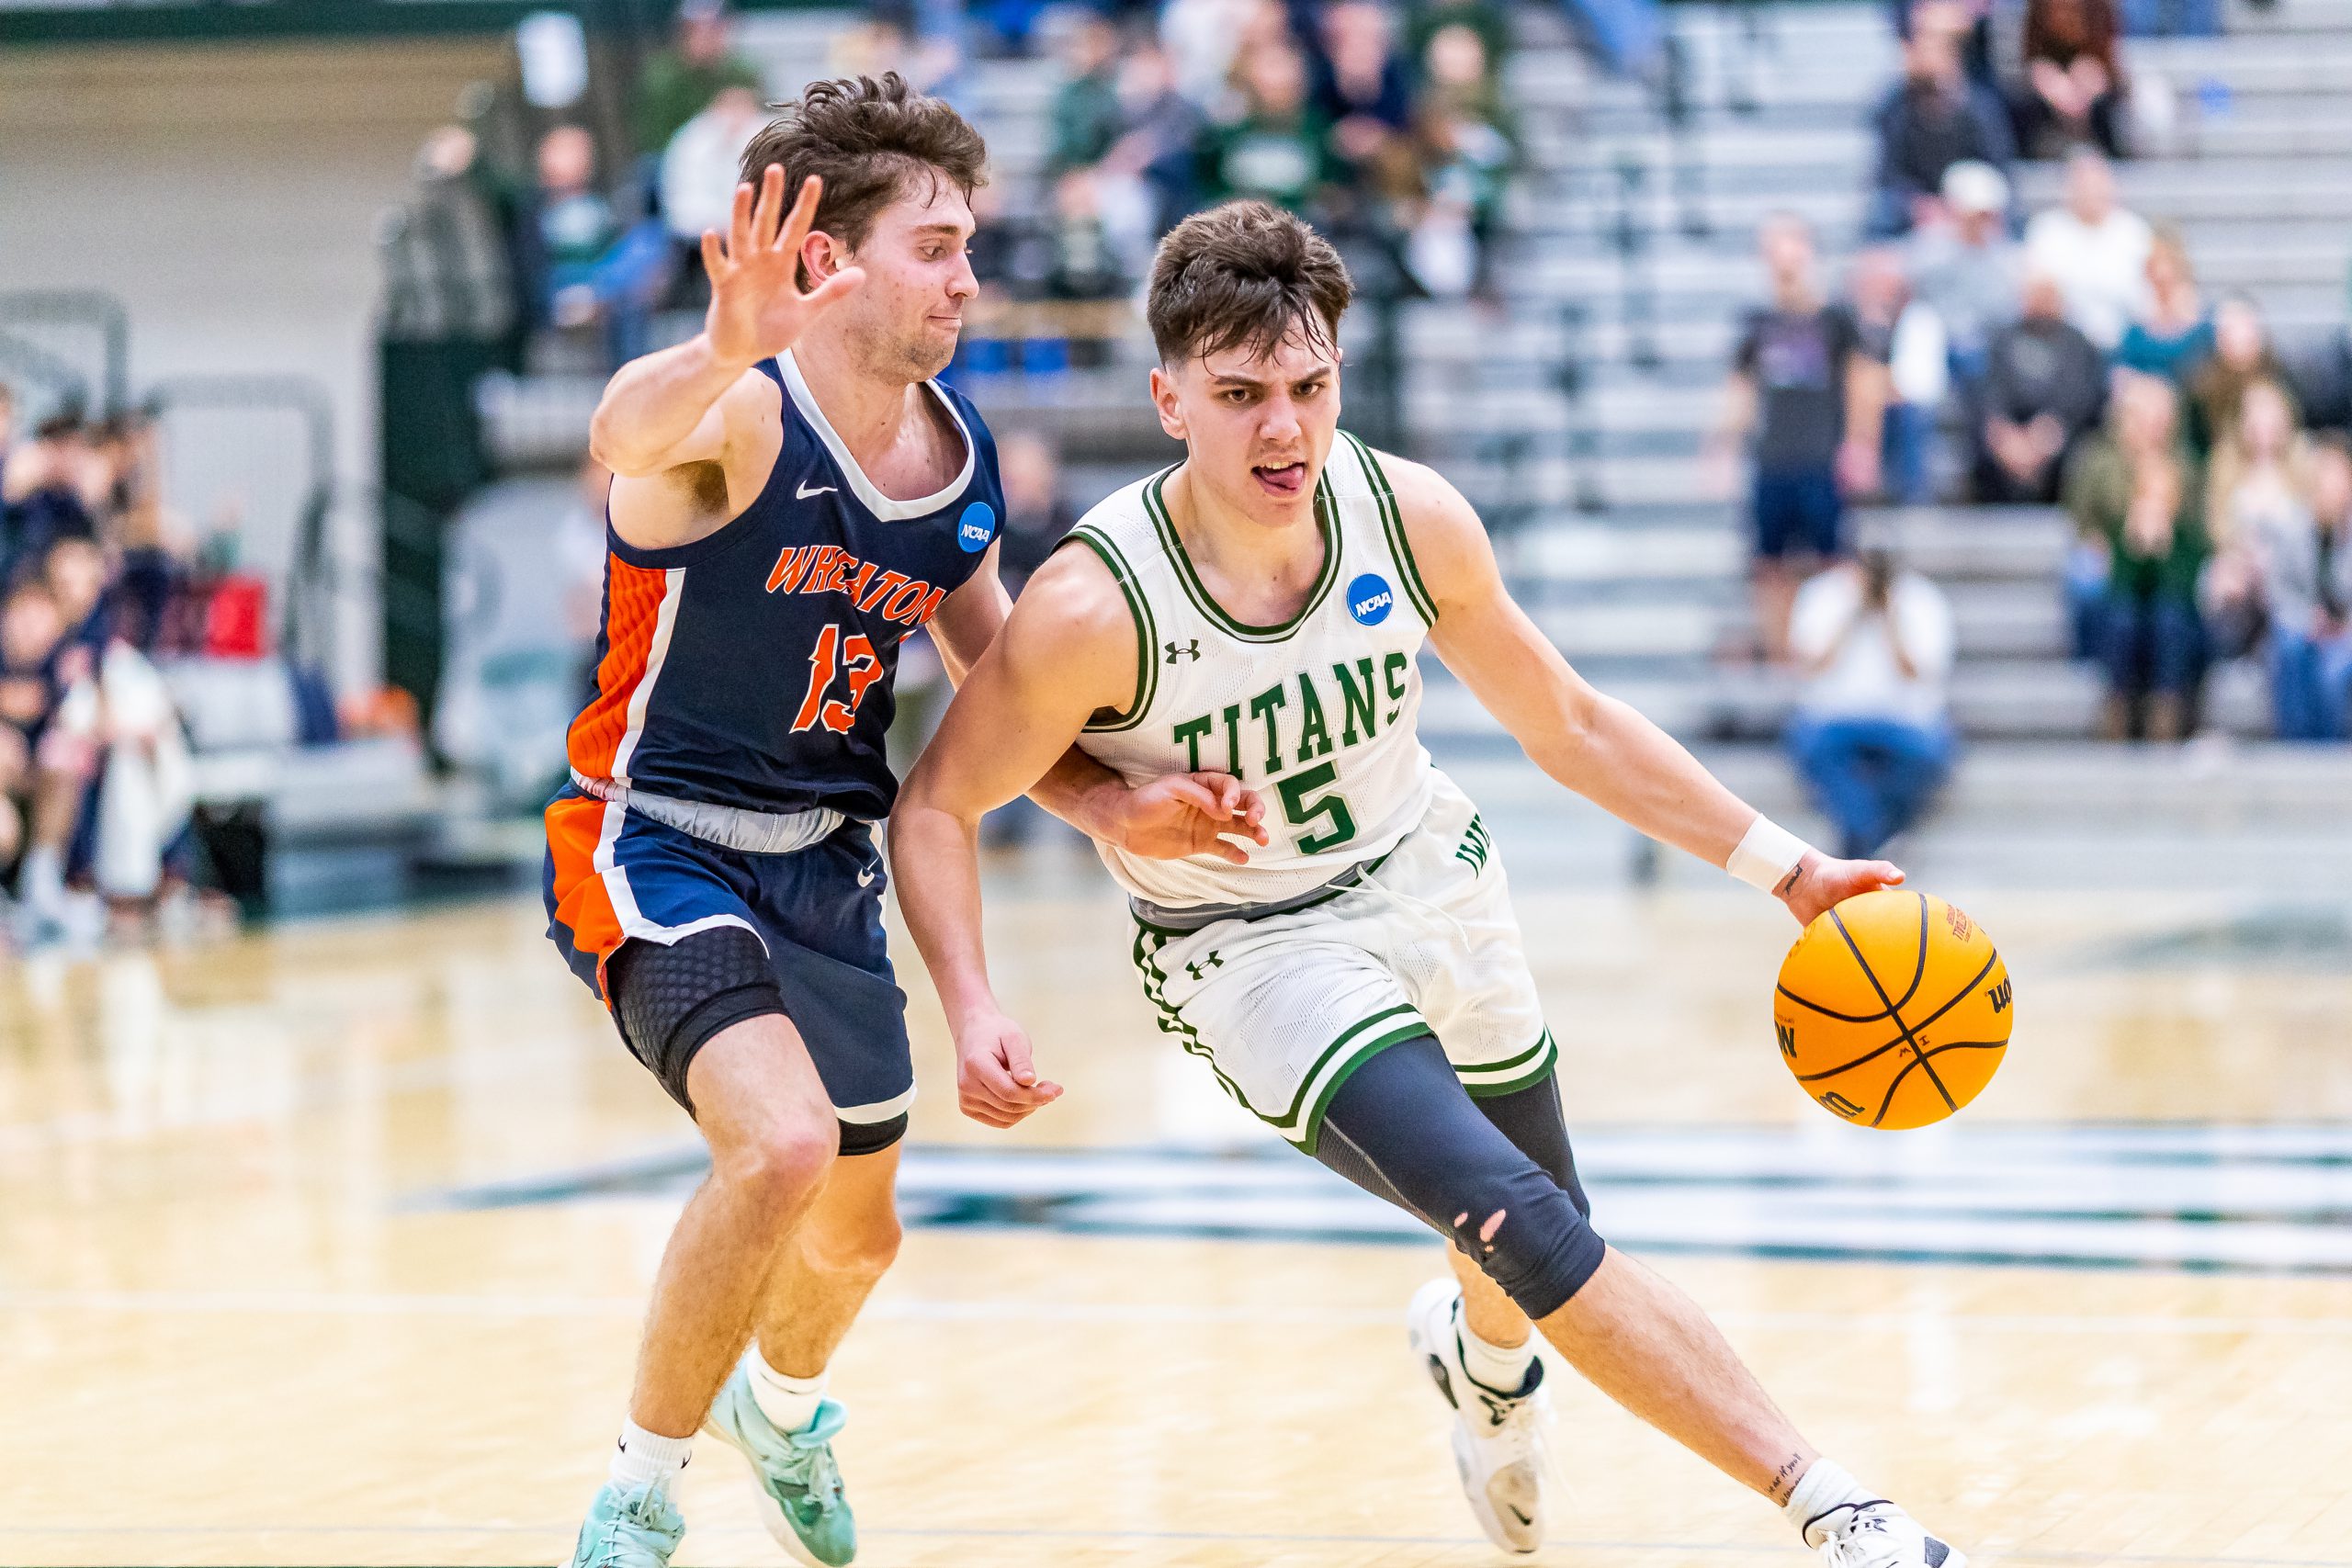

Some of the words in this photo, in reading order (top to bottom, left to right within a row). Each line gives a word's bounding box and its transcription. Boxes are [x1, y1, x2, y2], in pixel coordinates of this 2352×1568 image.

[961, 524, 990, 543] NCAA
[765, 545, 946, 626] WHEATON
[1355, 592, 1393, 617] NCAA
[788, 624, 884, 735] 13
[1173, 650, 1408, 781] TITANS
[1274, 761, 1359, 856] 5
